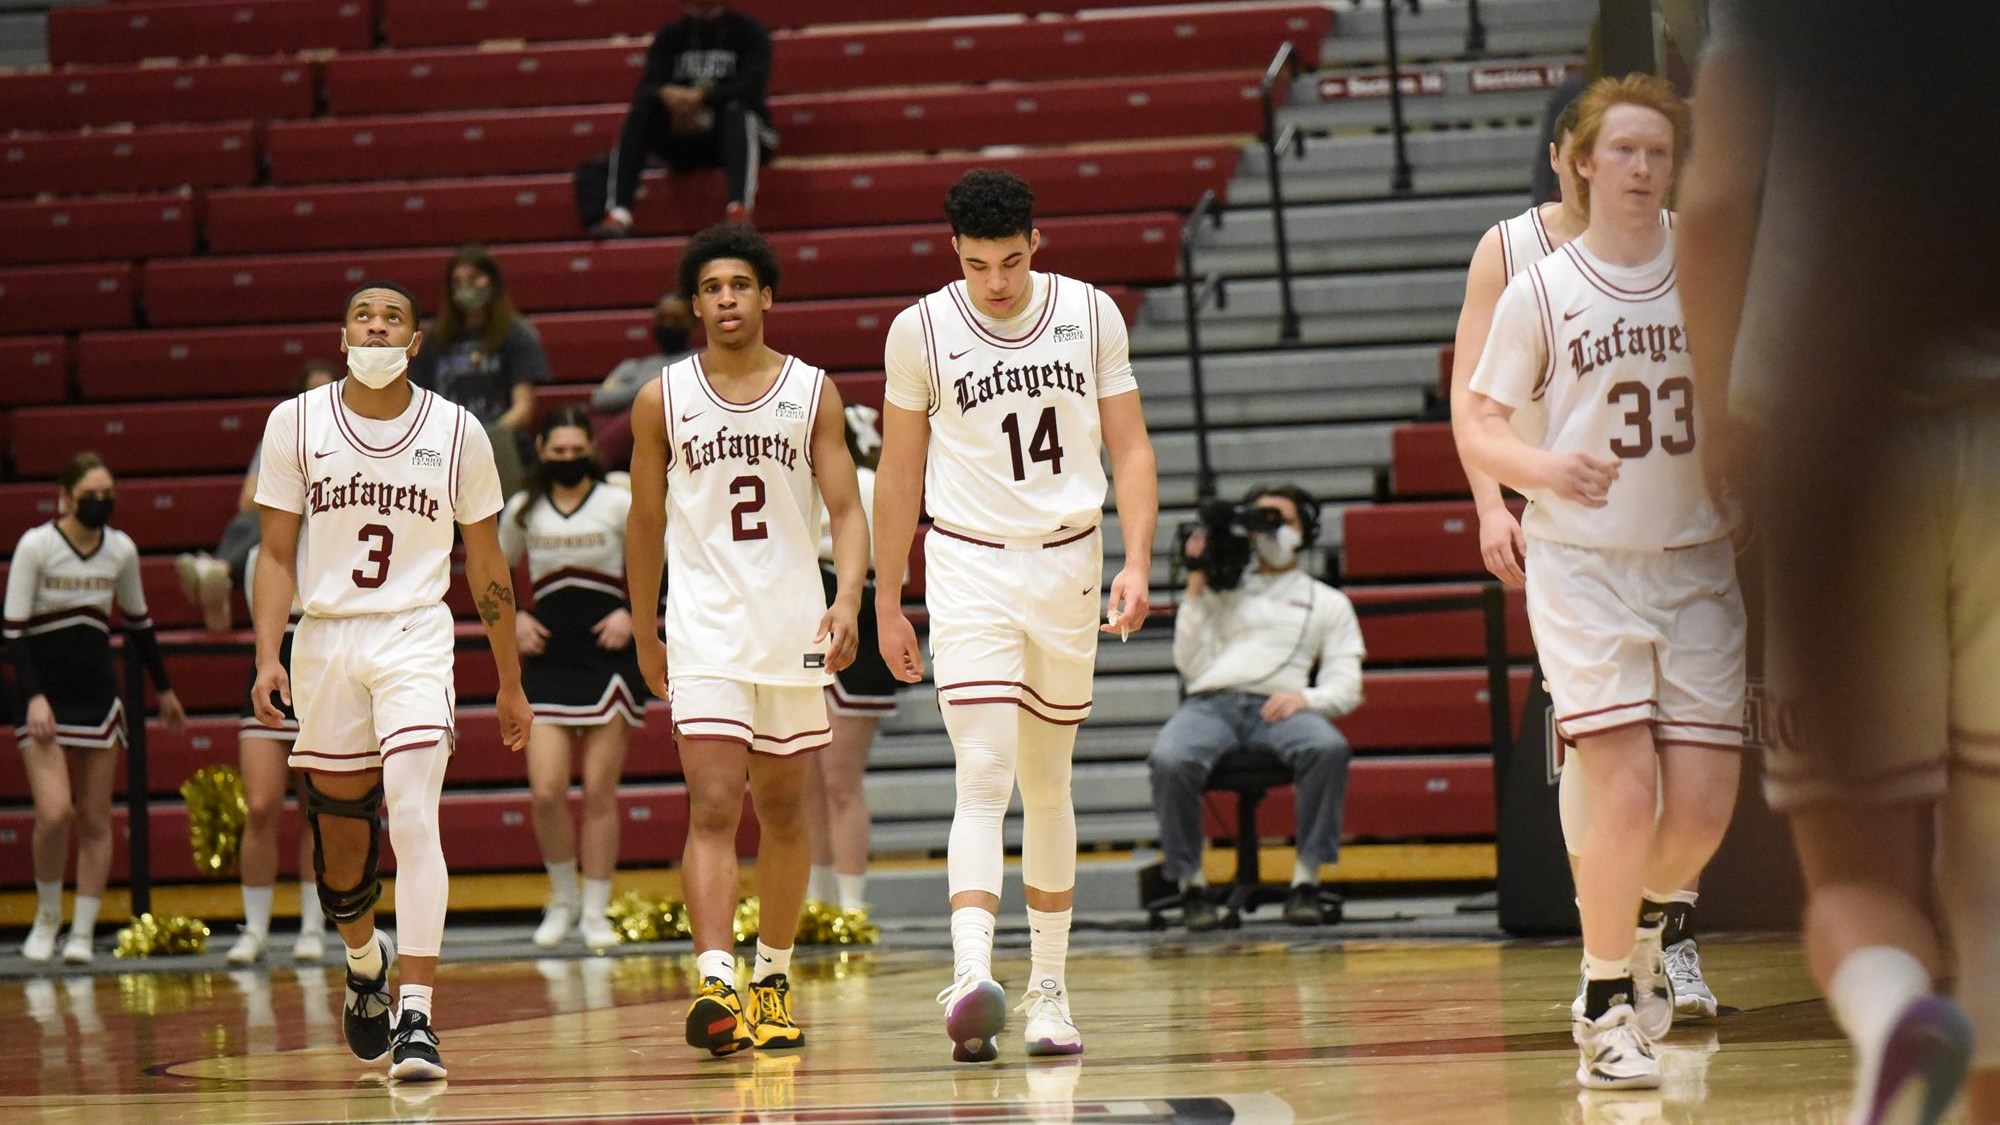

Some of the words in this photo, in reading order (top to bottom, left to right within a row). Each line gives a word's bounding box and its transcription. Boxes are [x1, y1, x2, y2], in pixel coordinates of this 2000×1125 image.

[1349, 76, 1420, 98] Secton
[953, 359, 1087, 417] Lafayette
[1607, 376, 1696, 459] 33
[682, 425, 797, 475] Lafayette
[1001, 406, 1064, 482] 14
[310, 471, 439, 522] Lafayette
[729, 475, 769, 541] 2
[351, 523, 394, 588] 3
